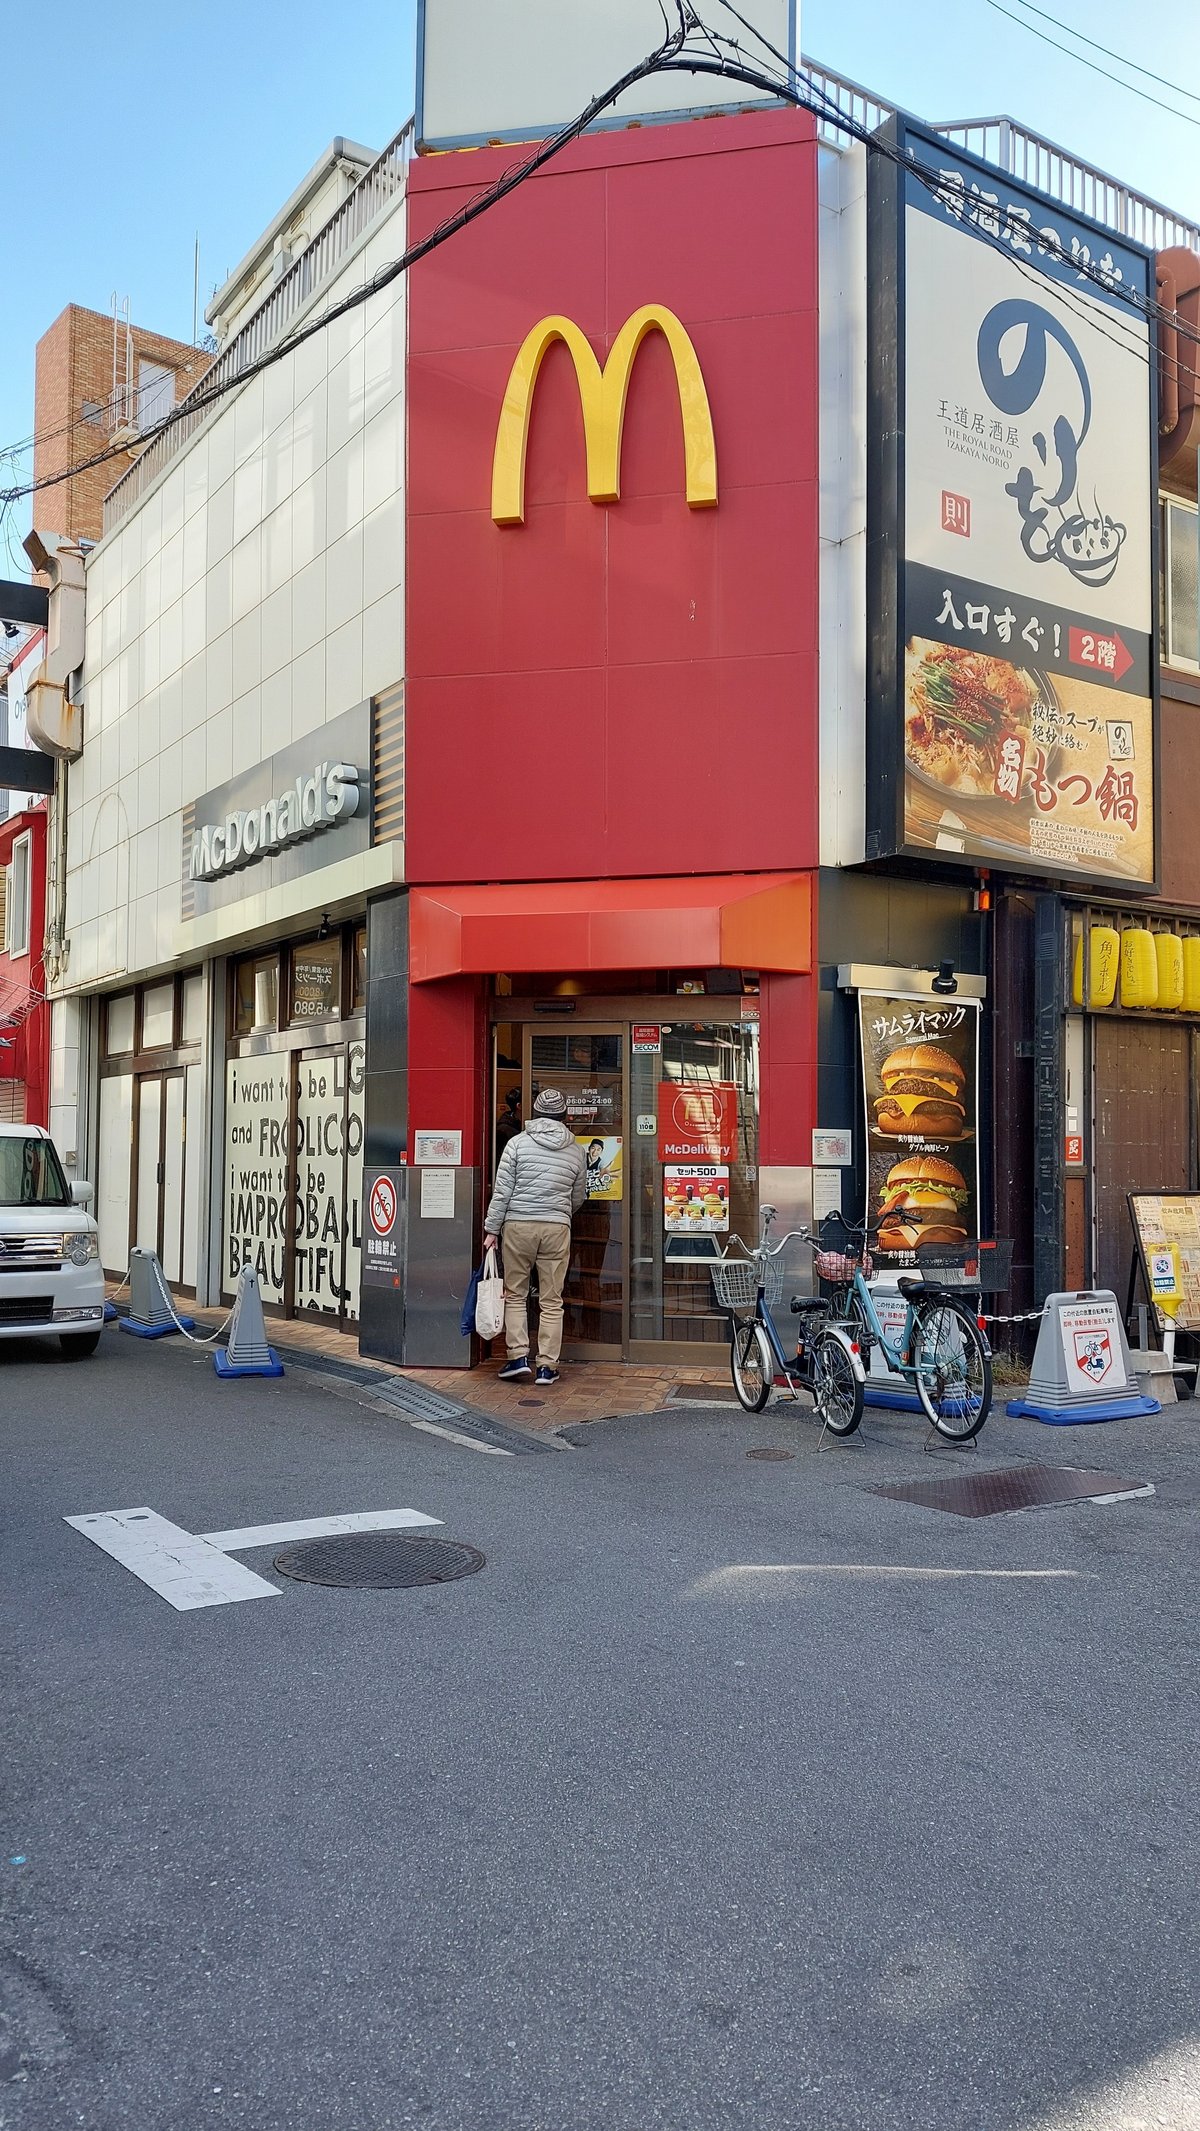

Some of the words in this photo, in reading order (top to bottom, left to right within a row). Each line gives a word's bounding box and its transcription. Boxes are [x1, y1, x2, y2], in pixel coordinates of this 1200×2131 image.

[936, 399, 1020, 449] 王道居酒屋
[944, 425, 961, 440] THE
[962, 433, 989, 451] ROYAL
[989, 443, 1013, 460] ROAD
[947, 439, 981, 460] IZAKAYA
[981, 452, 1010, 470] NORIO
[943, 495, 969, 534] 則
[1080, 635, 1117, 669] 2階
[1032, 701, 1105, 735] 秘伝のスープが
[997, 737, 1022, 798] 名物
[1025, 747, 1139, 832] もつ鍋
[190, 760, 360, 880] McDonald's
[1098, 940, 1113, 993] 角ハイボール
[872, 1006, 967, 1042] サムライマック
[905, 1033, 928, 1044] Samurai
[232, 1070, 237, 1104] i
[241, 1077, 274, 1104] want
[308, 1069, 327, 1098] be
[333, 1044, 365, 1097] LG
[231, 1119, 253, 1144] and
[664, 1143, 731, 1157] McDelivery
[231, 1163, 235, 1191] i
[239, 1168, 273, 1192] want
[307, 1163, 326, 1194] be
[676, 1167, 717, 1176] セット500
[367, 1239, 397, 1257] 駐輪禁止
